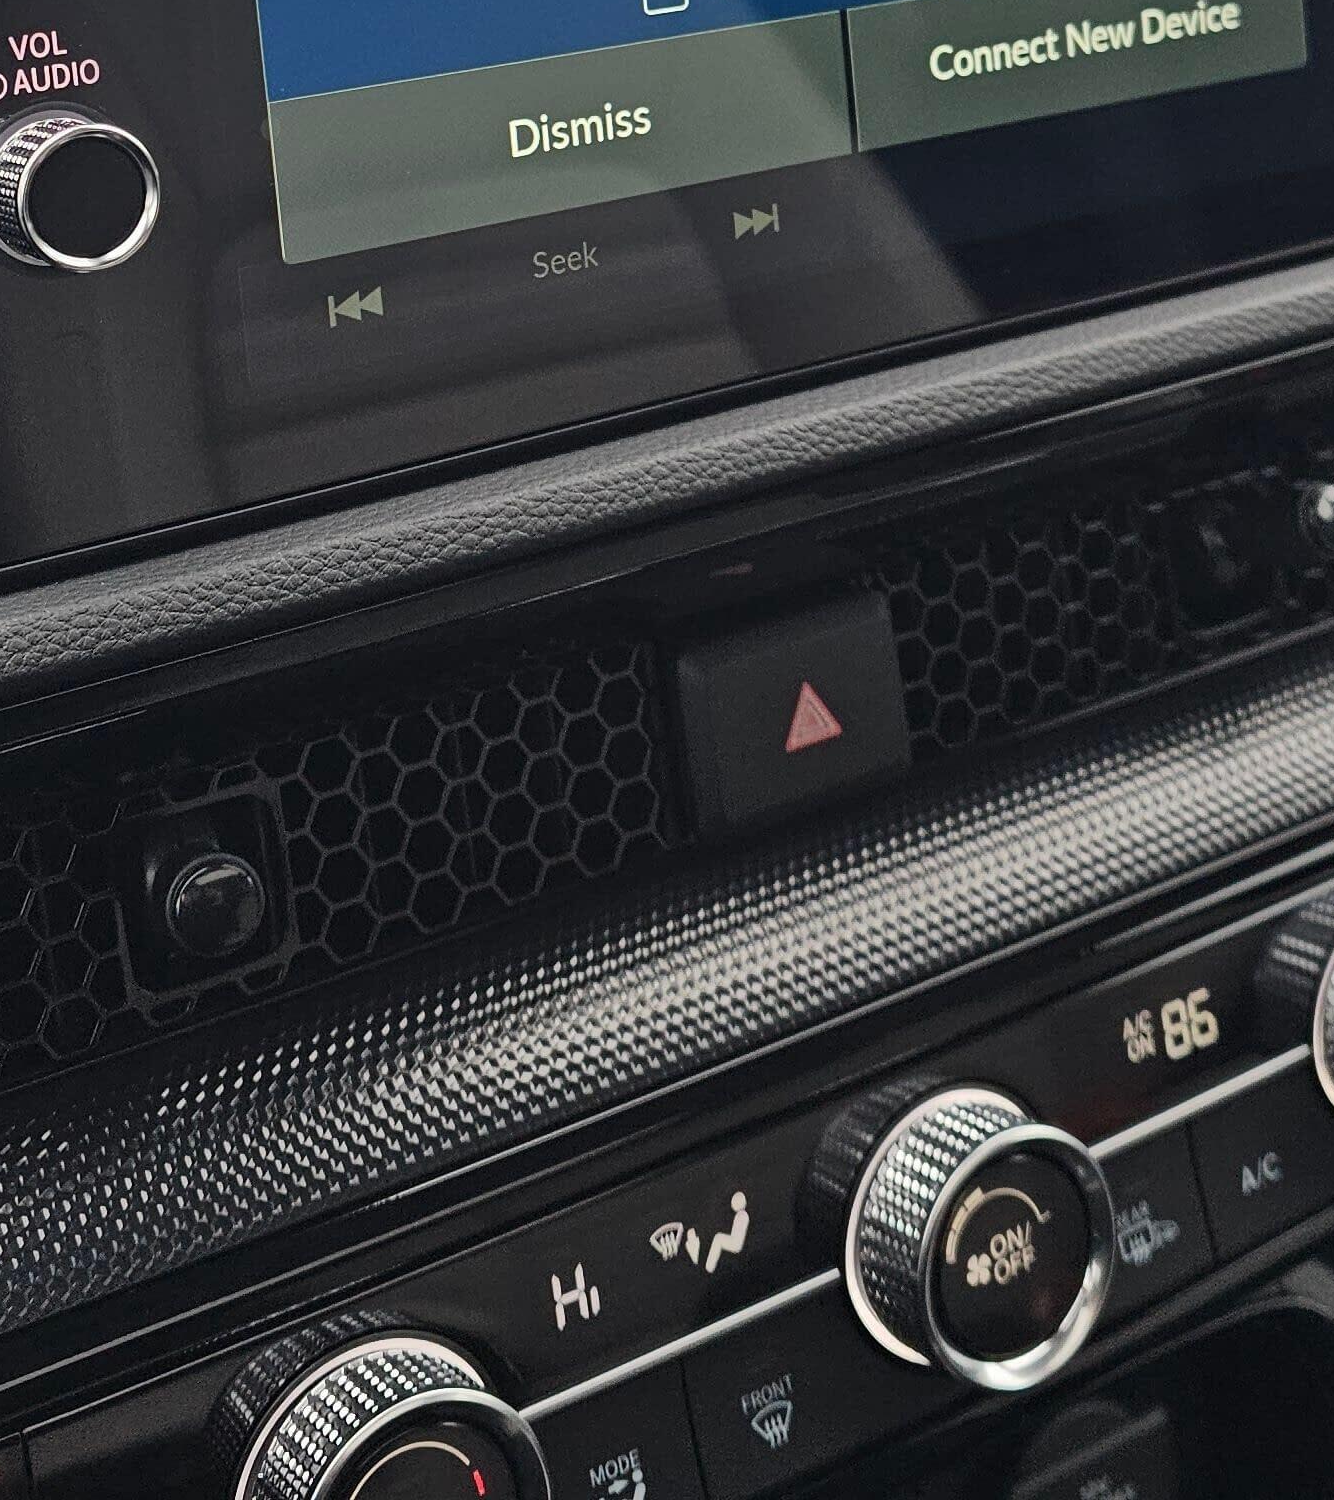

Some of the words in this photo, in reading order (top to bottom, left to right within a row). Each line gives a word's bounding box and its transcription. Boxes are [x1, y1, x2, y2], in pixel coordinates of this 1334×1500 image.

[8, 31, 68, 61] VOL
[929, 30, 1059, 81] Connect
[1065, 19, 1134, 57] New
[13, 58, 100, 96] AUDIO
[509, 102, 652, 158] Dismiss
[532, 241, 599, 279] Seek
[1161, 987, 1219, 1059] 86
[1242, 1152, 1283, 1196] A/C
[994, 1244, 1037, 1285] OFF
[741, 1373, 793, 1415] FRONT
[589, 1449, 642, 1488] MODE
